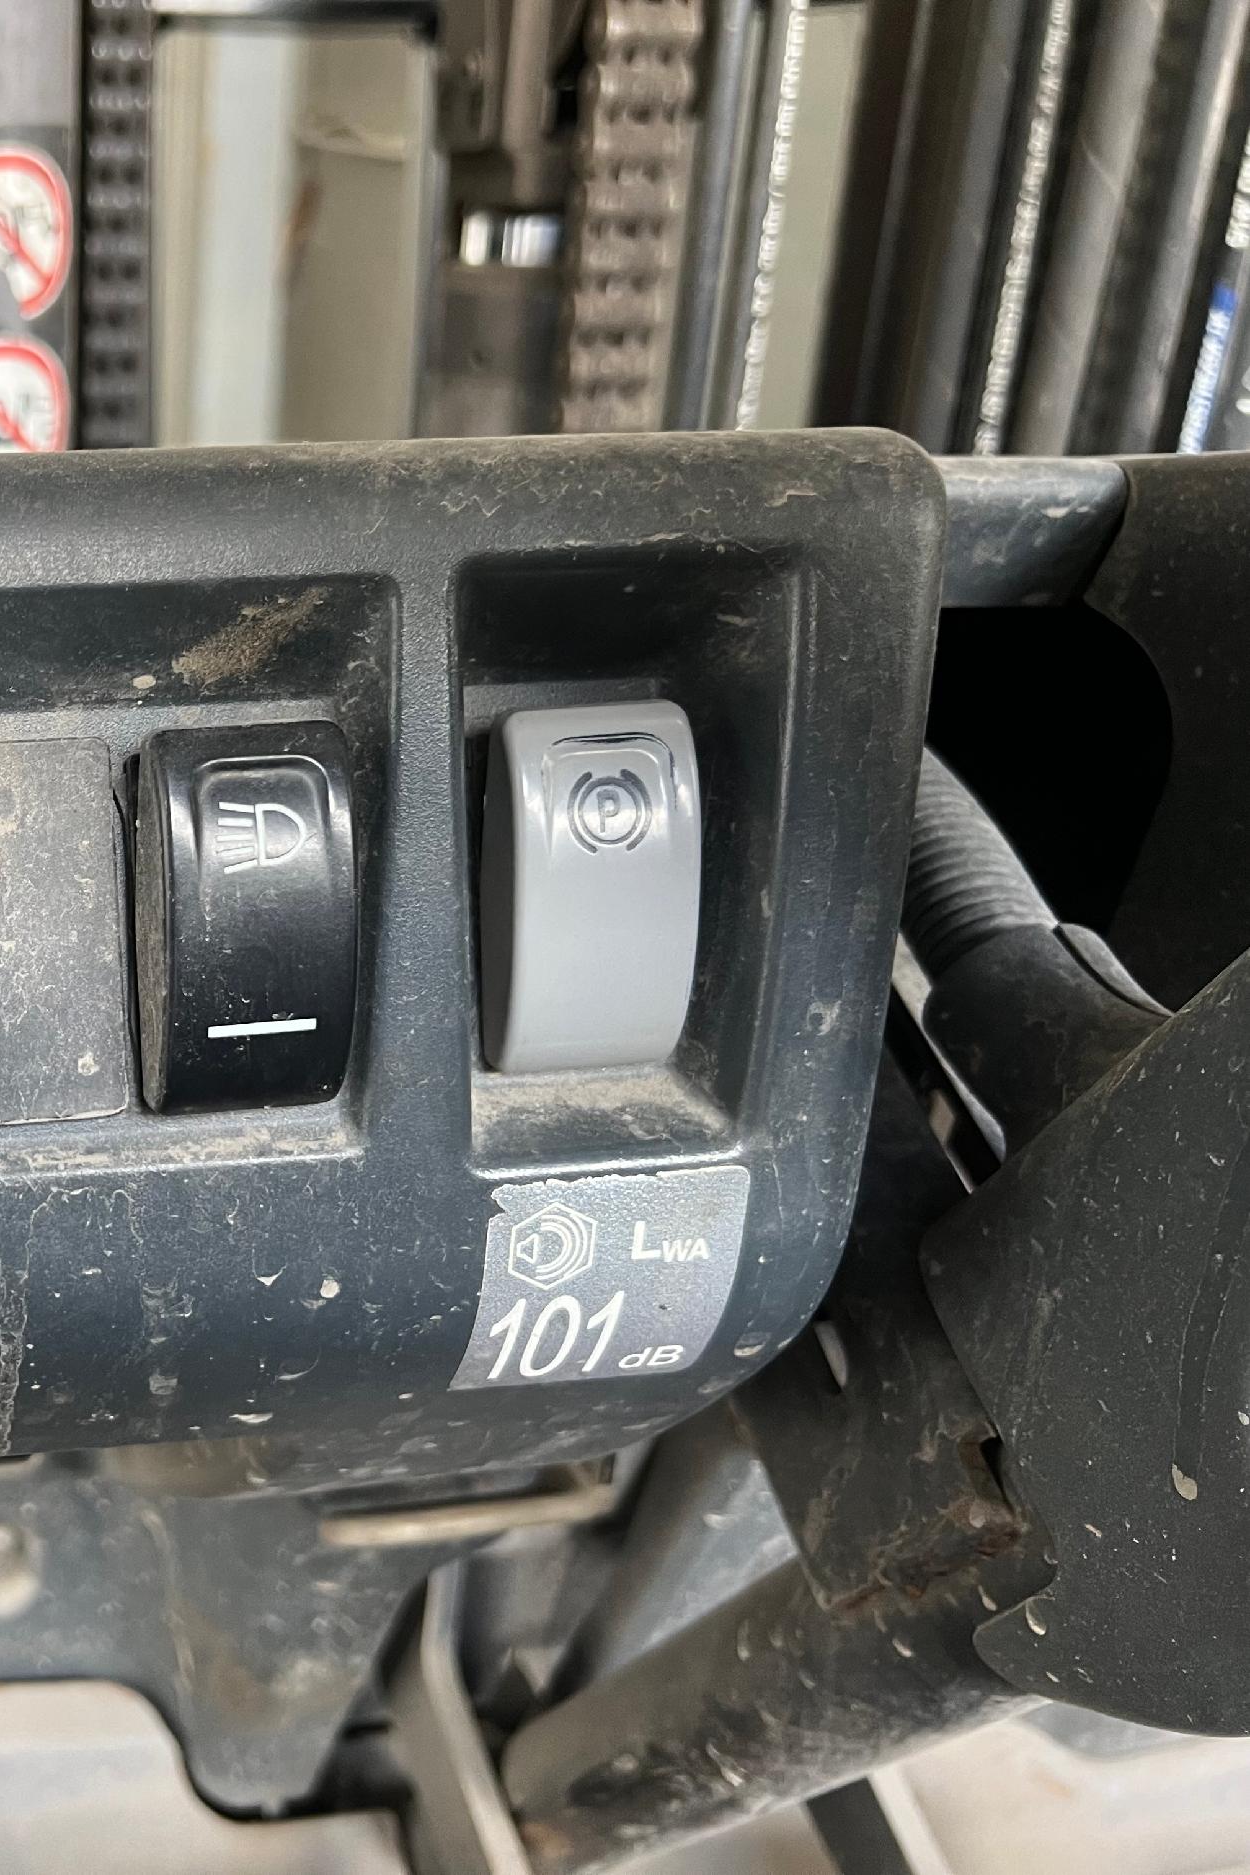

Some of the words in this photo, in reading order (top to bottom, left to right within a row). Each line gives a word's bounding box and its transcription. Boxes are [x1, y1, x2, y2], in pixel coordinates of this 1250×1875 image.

[596, 789, 620, 834] P
[486, 1290, 625, 1381] 101
[618, 1344, 684, 1369] dB
